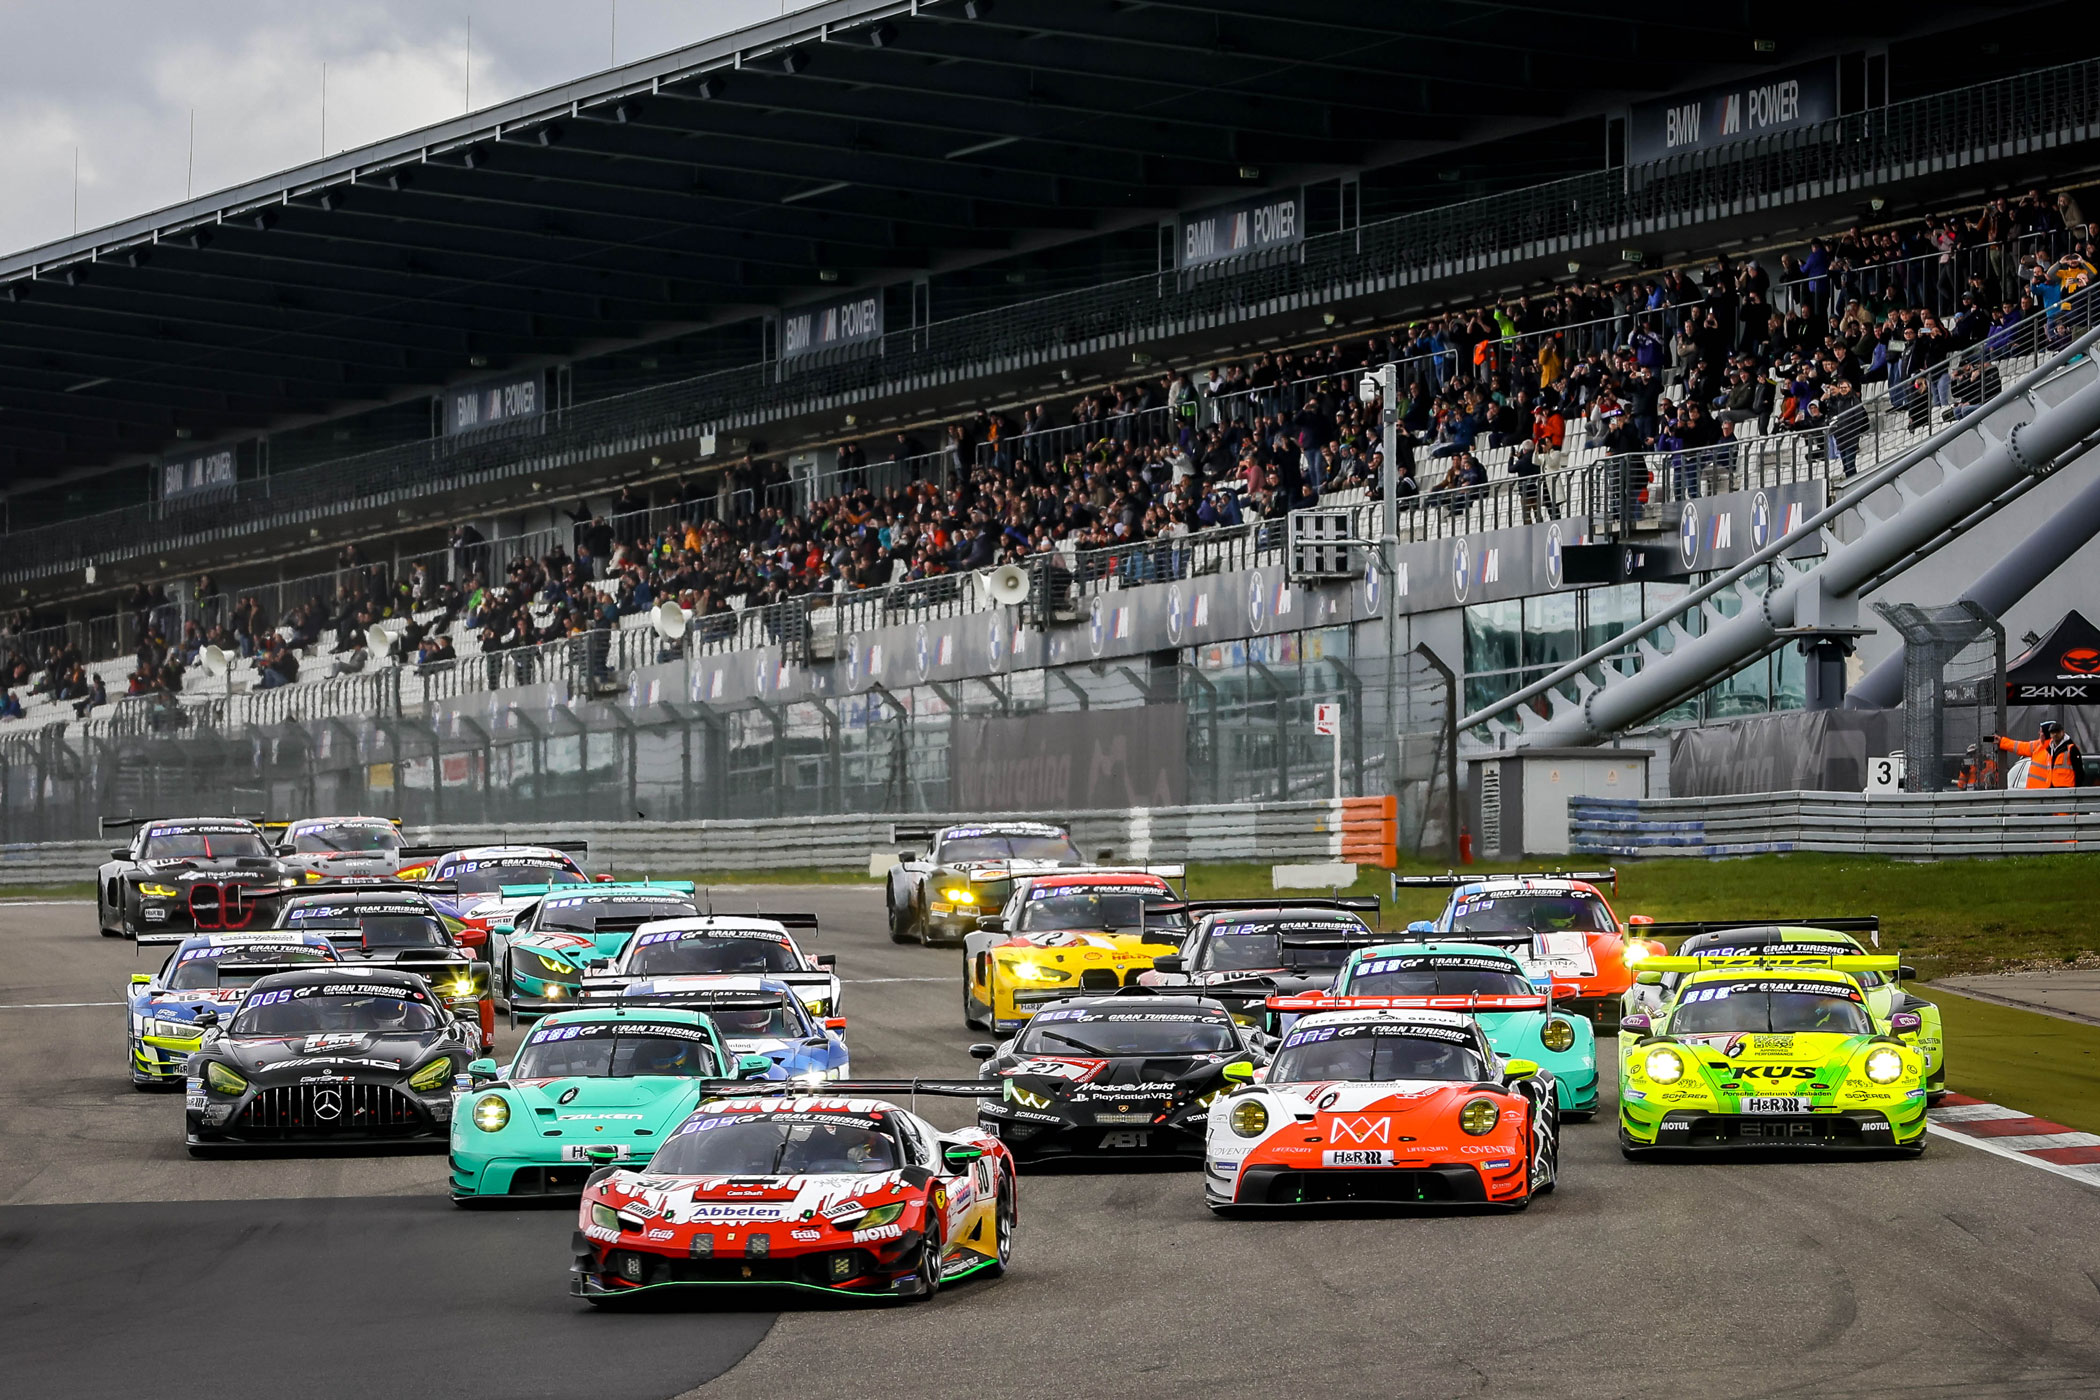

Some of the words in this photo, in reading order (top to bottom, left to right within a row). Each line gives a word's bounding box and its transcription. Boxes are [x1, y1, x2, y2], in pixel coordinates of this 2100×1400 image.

[1667, 102, 1701, 148] BMW
[1721, 93, 1740, 136] M
[1749, 80, 1799, 129] POWER
[1187, 218, 1215, 259] BMW
[1254, 200, 1295, 244] POWER
[787, 314, 811, 351] BMW
[842, 298, 876, 338] POWER
[505, 381, 535, 416] POWER
[2020, 685, 2088, 698] 24MX
[1877, 761, 1892, 785] 3
[501, 859, 525, 867] GRAN
[526, 859, 563, 869] TURISMO
[1403, 872, 1600, 882] PORSCHE
[1122, 886, 1164, 896] TURISMO
[1520, 889, 1563, 897] TURISMO
[383, 906, 424, 915] TURISMO
[708, 930, 736, 938] GRAN
[738, 931, 783, 941] TURISMO
[280, 945, 326, 957] TURISMO
[1763, 944, 1794, 953] GRAN
[1796, 944, 1846, 955] TURISMO
[1464, 958, 1513, 970] TURISMO
[358, 985, 407, 996] TURISMO
[1760, 983, 1796, 991] GRAN
[1797, 983, 1850, 995] TURISMO
[1278, 997, 1541, 1007] PORSCHE
[649, 1025, 702, 1038] TURISMO
[1410, 1026, 1466, 1039] TURISMO
[1026, 1063, 1065, 1074] 27
[1077, 1060, 1107, 1083] NORDRHEIN
[1732, 1066, 1817, 1079] KÜS
[1073, 1082, 1121, 1092] Media
[1133, 1082, 1176, 1091] Markt
[1092, 1093, 1150, 1102] PlayStation
[1749, 1098, 1780, 1112] H&R
[556, 1113, 643, 1121] FALKEN
[771, 1113, 811, 1121] GRAN
[813, 1114, 874, 1127] TURISMO
[1014, 1111, 1060, 1122] SCHAEFFLER
[1660, 1122, 1690, 1130] MOTUL
[1861, 1122, 1890, 1131] MOTUL
[1098, 1130, 1153, 1149] ABT
[1460, 1146, 1516, 1155] COVENTRY
[1334, 1151, 1363, 1164] H&R
[637, 1180, 680, 1191] 30
[694, 1206, 780, 1217] Abbelen
[585, 1224, 622, 1244] MOTUL
[852, 1223, 903, 1244] MOTUL
